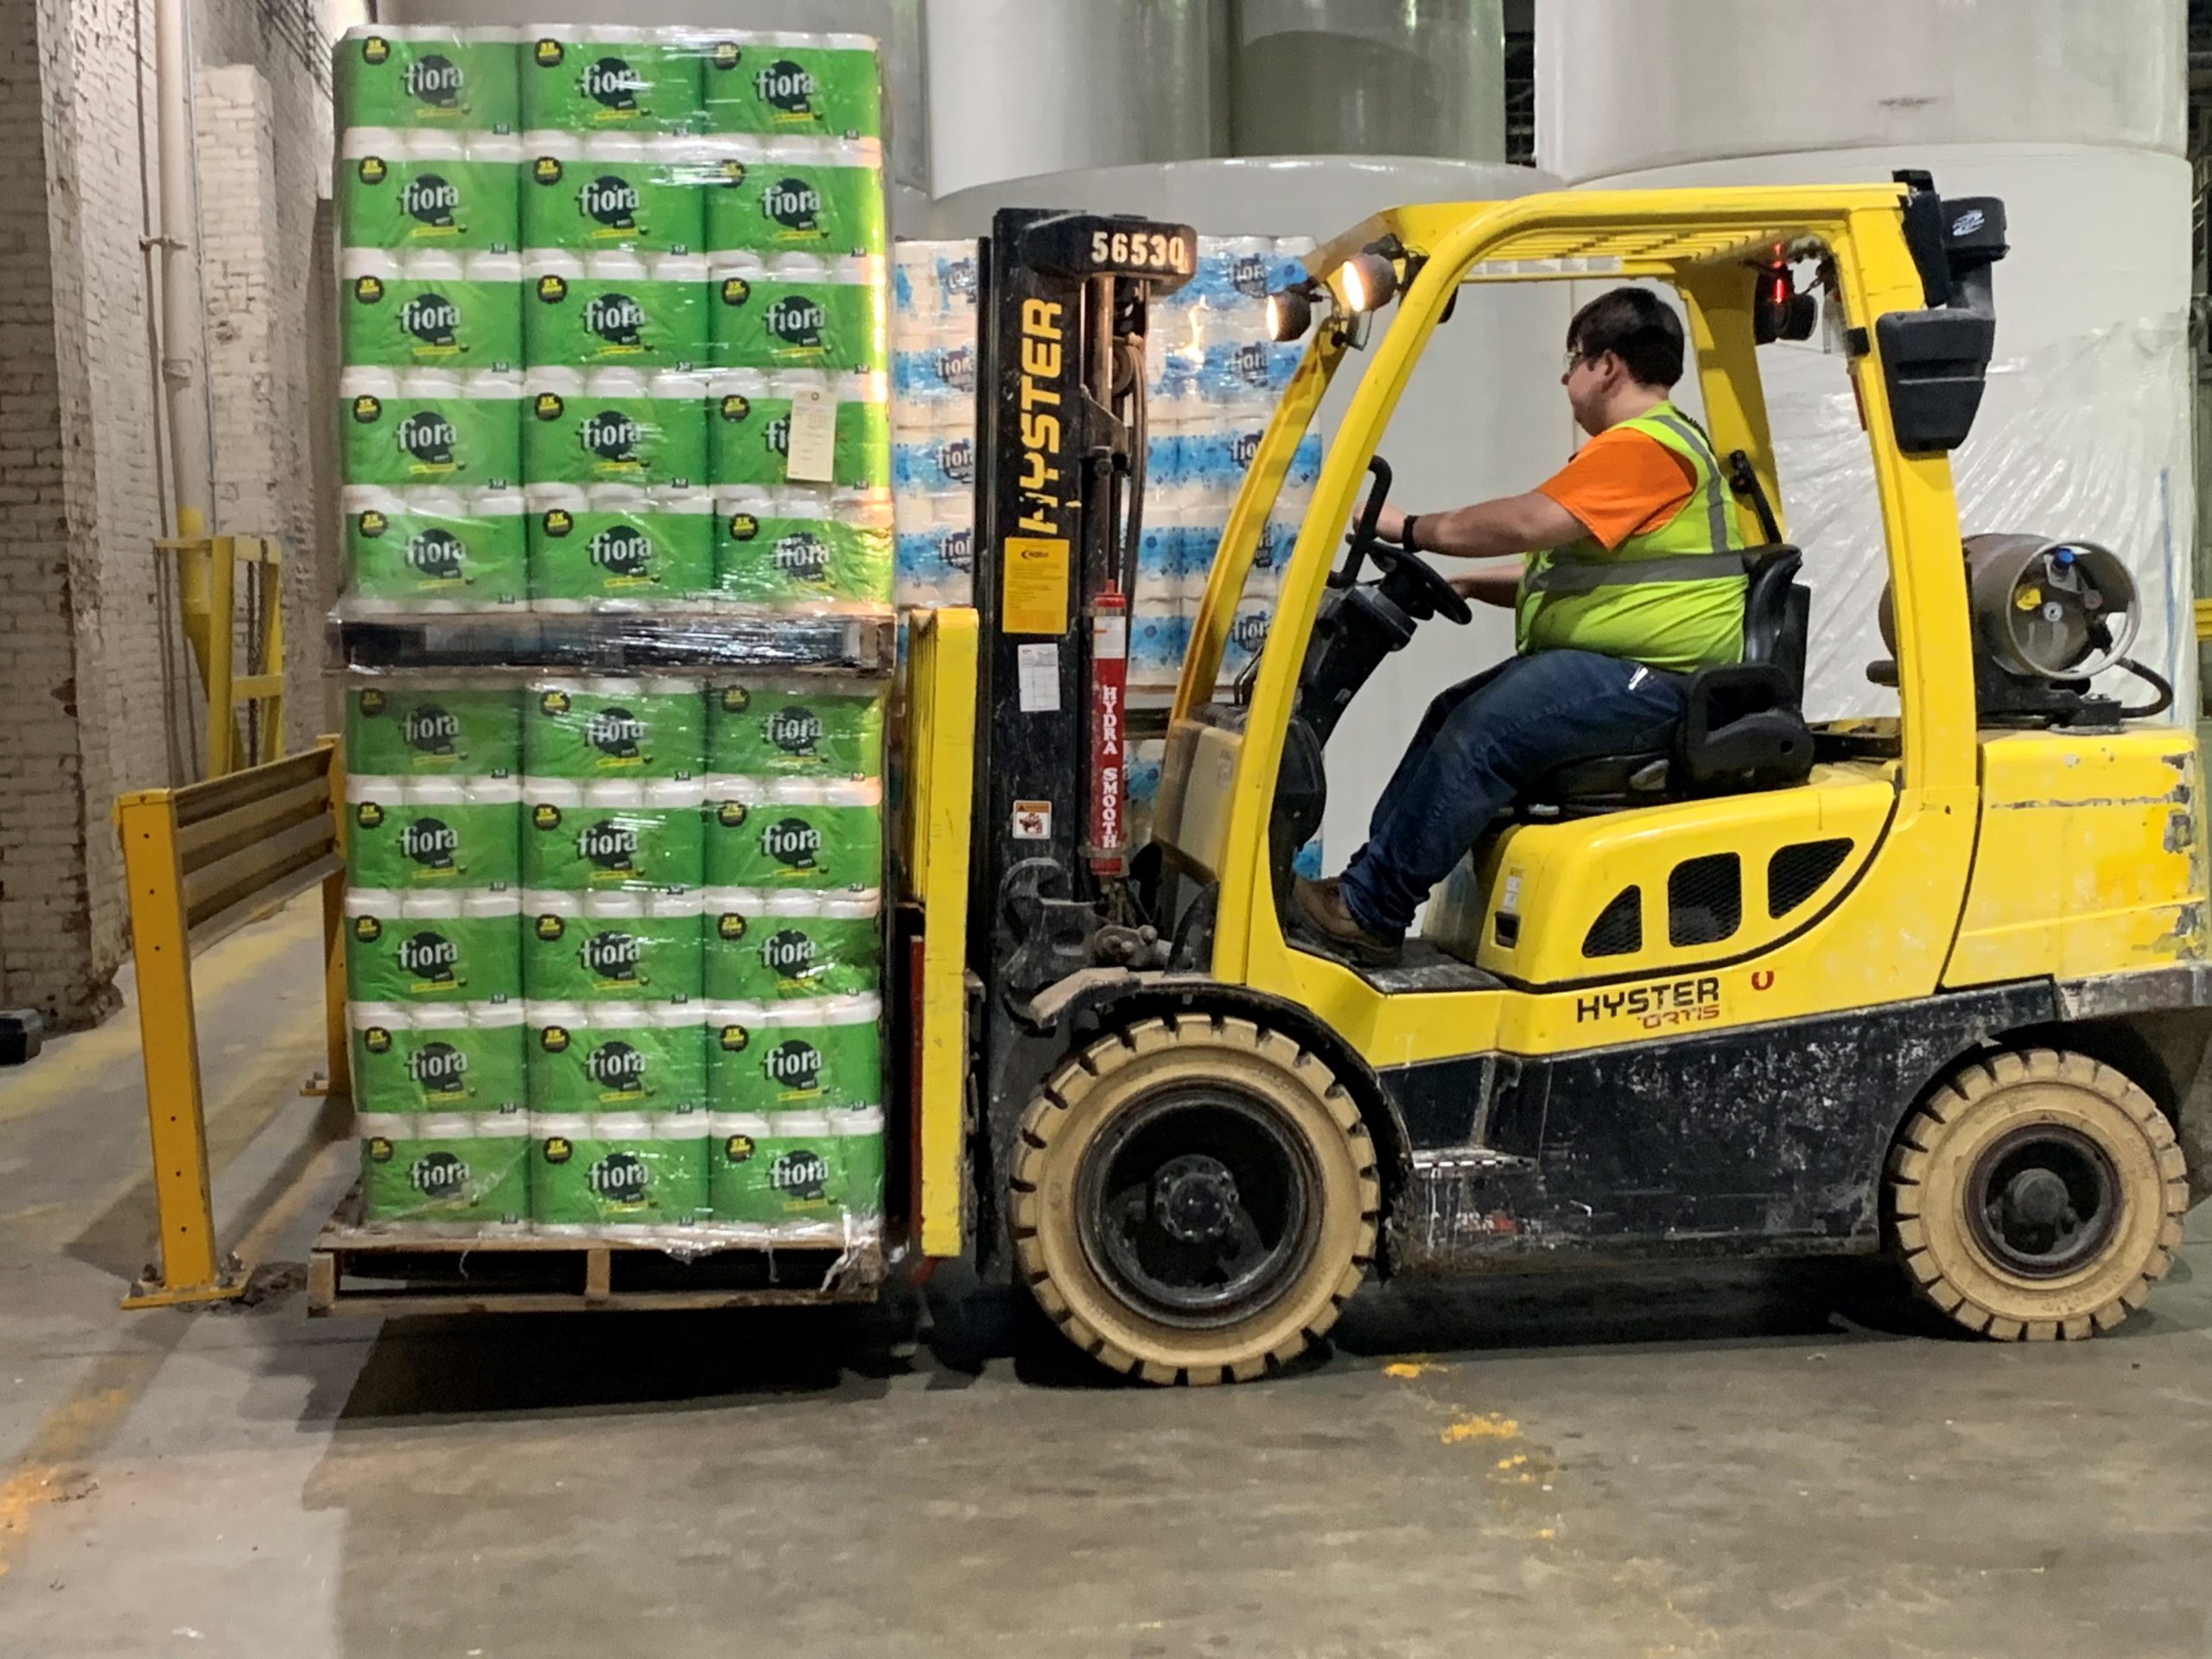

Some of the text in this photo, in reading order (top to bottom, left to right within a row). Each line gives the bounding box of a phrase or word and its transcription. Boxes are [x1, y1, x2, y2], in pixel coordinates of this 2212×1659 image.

[403, 61, 463, 94] fiora
[755, 69, 814, 99] fiora
[400, 182, 458, 212] fiora
[578, 183, 639, 213] fiora
[762, 186, 820, 215] fiora
[1091, 231, 1185, 266] 56530
[399, 302, 460, 332] fiora
[583, 300, 645, 332] fiora
[765, 303, 824, 332] fiora
[1019, 298, 1062, 535] HYSTER
[397, 418, 456, 448] fiora
[581, 419, 641, 448] fiora
[407, 536, 466, 563] fiora
[589, 533, 651, 563] fiora
[403, 713, 459, 741] fiora
[1102, 684, 1118, 849] HYDRA SMOOTH
[400, 826, 457, 855] fiora
[576, 829, 637, 855] fiora
[761, 825, 820, 855] fiora
[397, 938, 457, 968] fiora
[580, 938, 640, 967] fiora
[760, 937, 816, 966] fiora
[1577, 976, 1719, 1023] HYSTER
[408, 1050, 467, 1079] fiora
[585, 1049, 645, 1077] fiora
[764, 1047, 821, 1077] fiora
[410, 1160, 469, 1188] fiora
[589, 1160, 648, 1190] fiora
